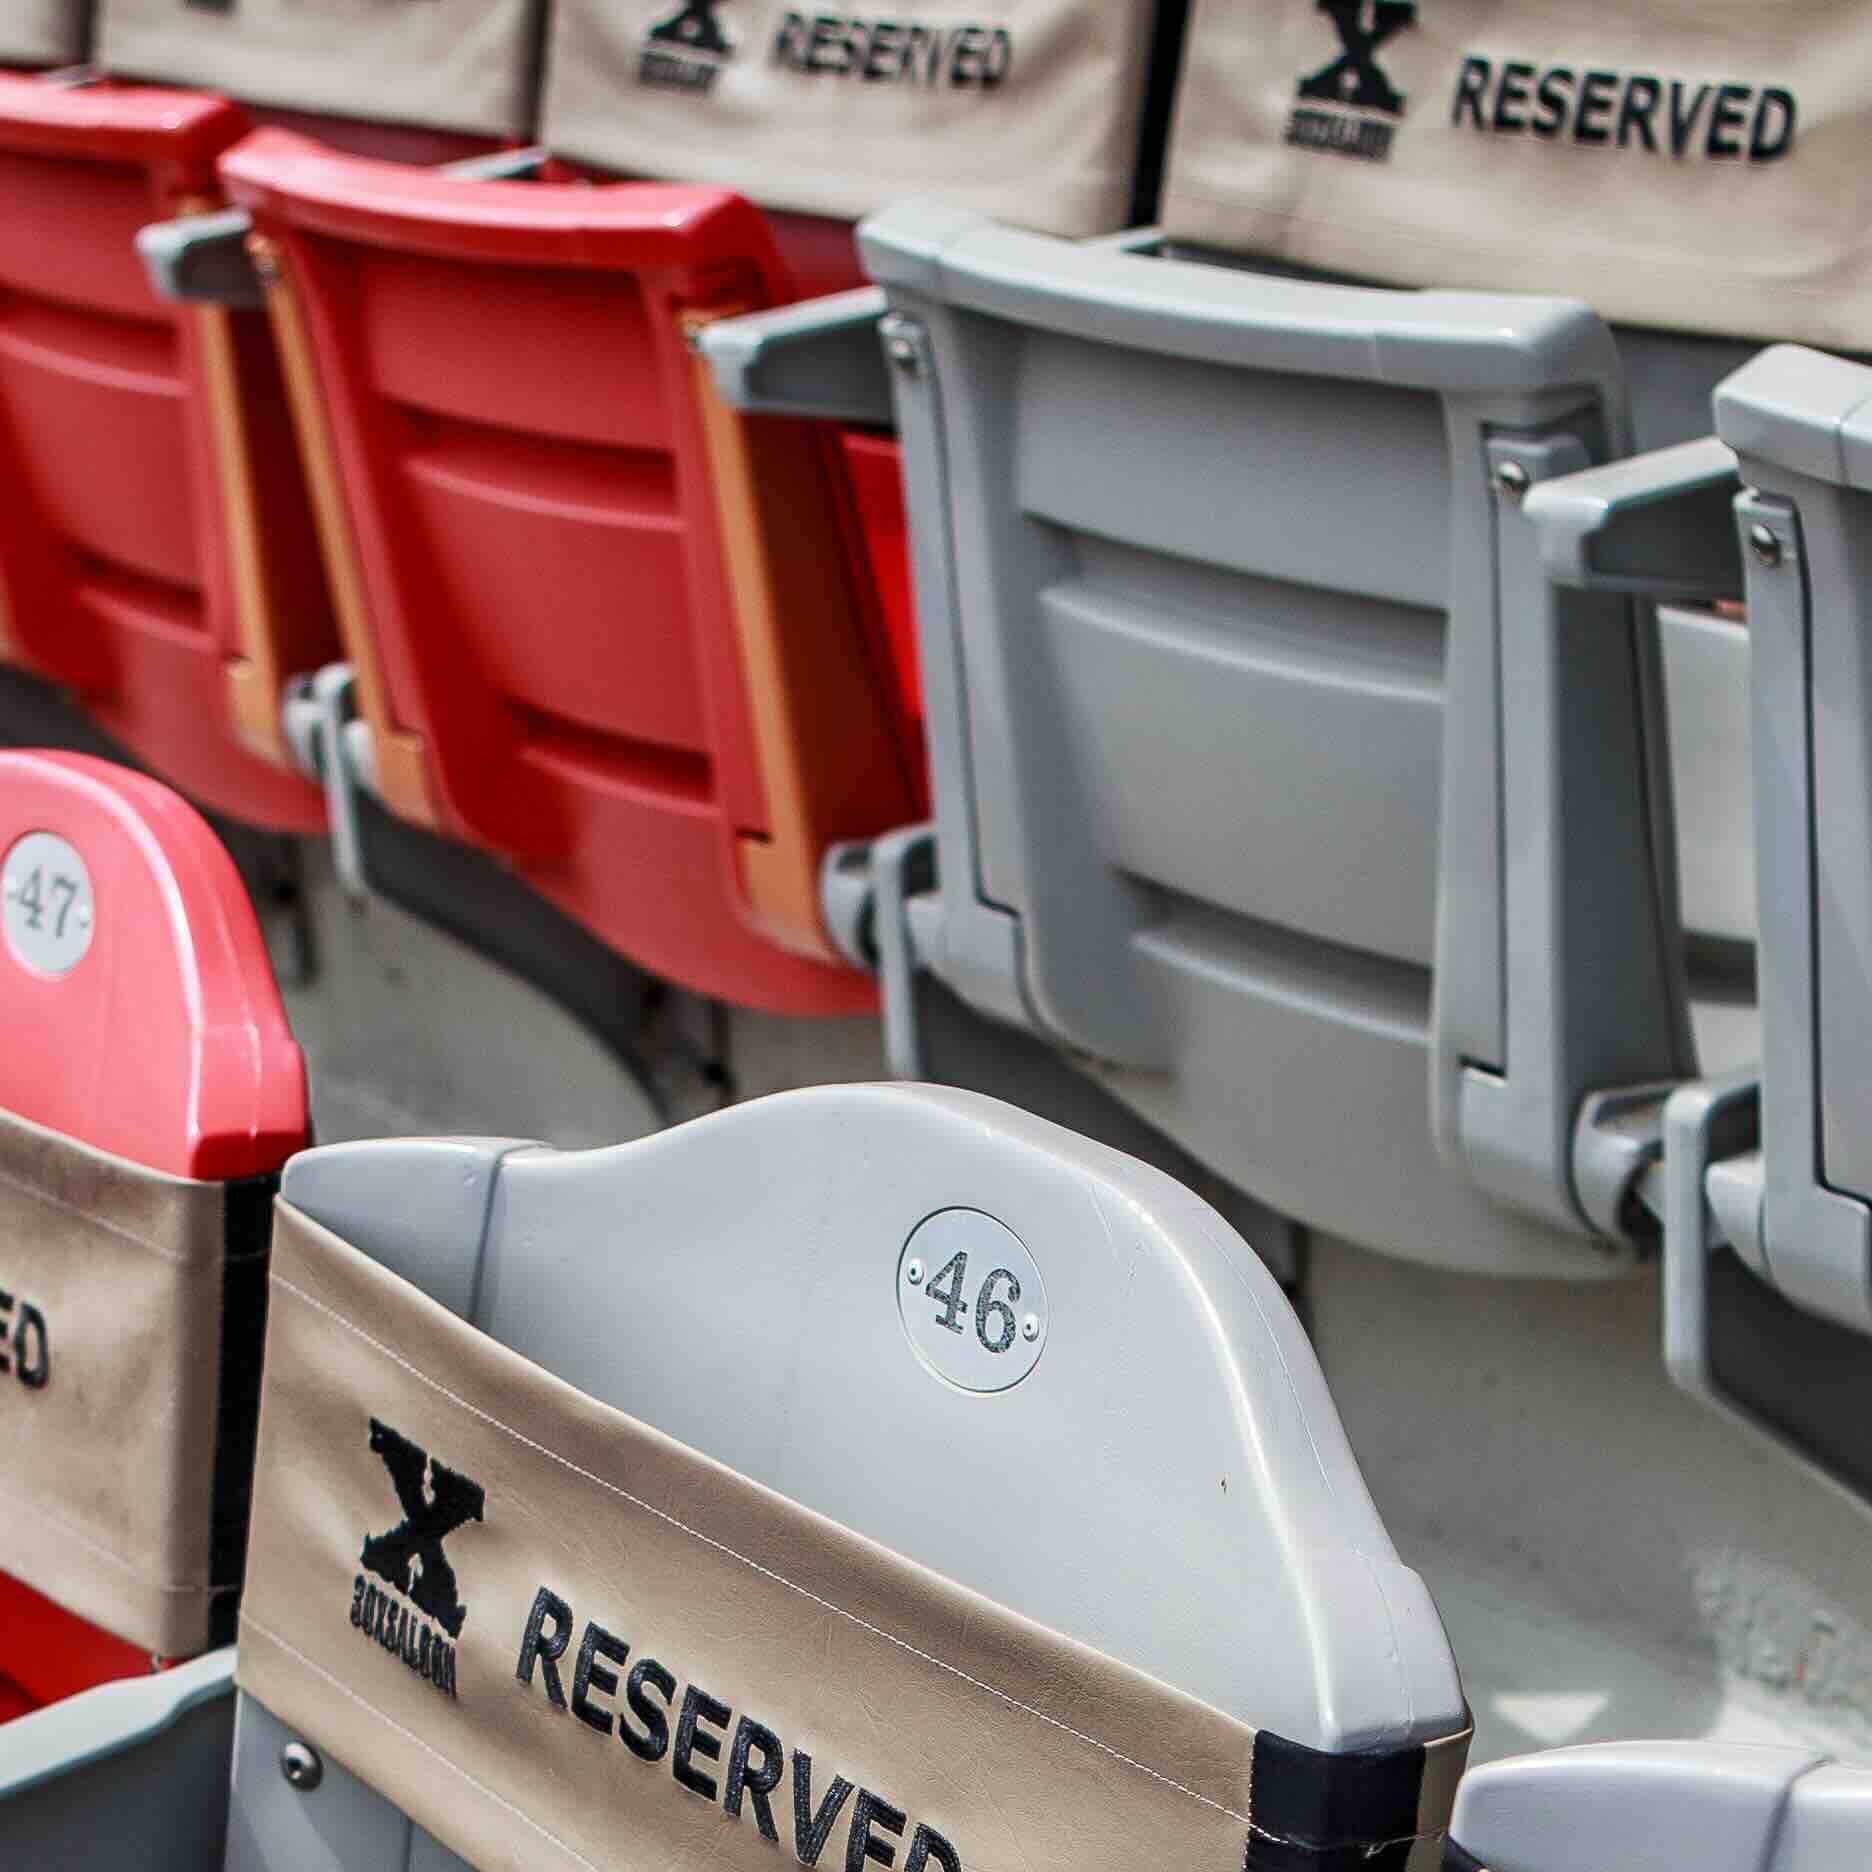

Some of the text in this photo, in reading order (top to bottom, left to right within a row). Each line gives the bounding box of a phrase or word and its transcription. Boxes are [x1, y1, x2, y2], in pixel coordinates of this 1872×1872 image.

[1450, 56, 1797, 163] RESERVED
[14, 867, 78, 940] 47
[925, 1250, 1021, 1354] 46
[360, 1416, 485, 1640] X
